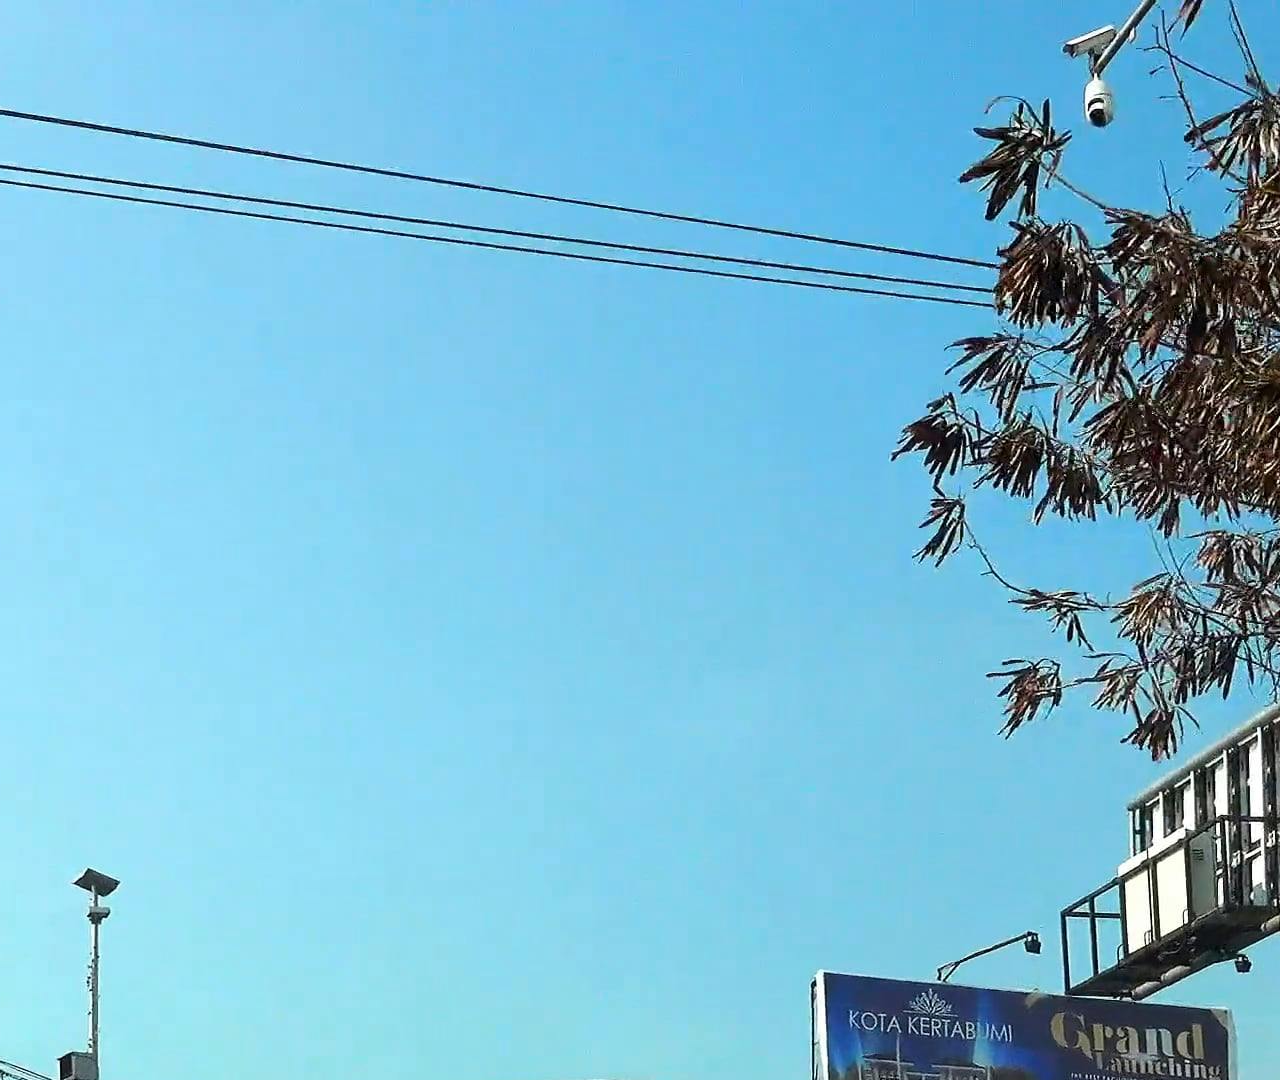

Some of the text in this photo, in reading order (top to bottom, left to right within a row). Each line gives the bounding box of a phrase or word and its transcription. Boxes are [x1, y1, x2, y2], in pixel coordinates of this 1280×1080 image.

[849, 1010, 1013, 1043] KOTA KERTABUMI
[1050, 1011, 1205, 1060] Grand
